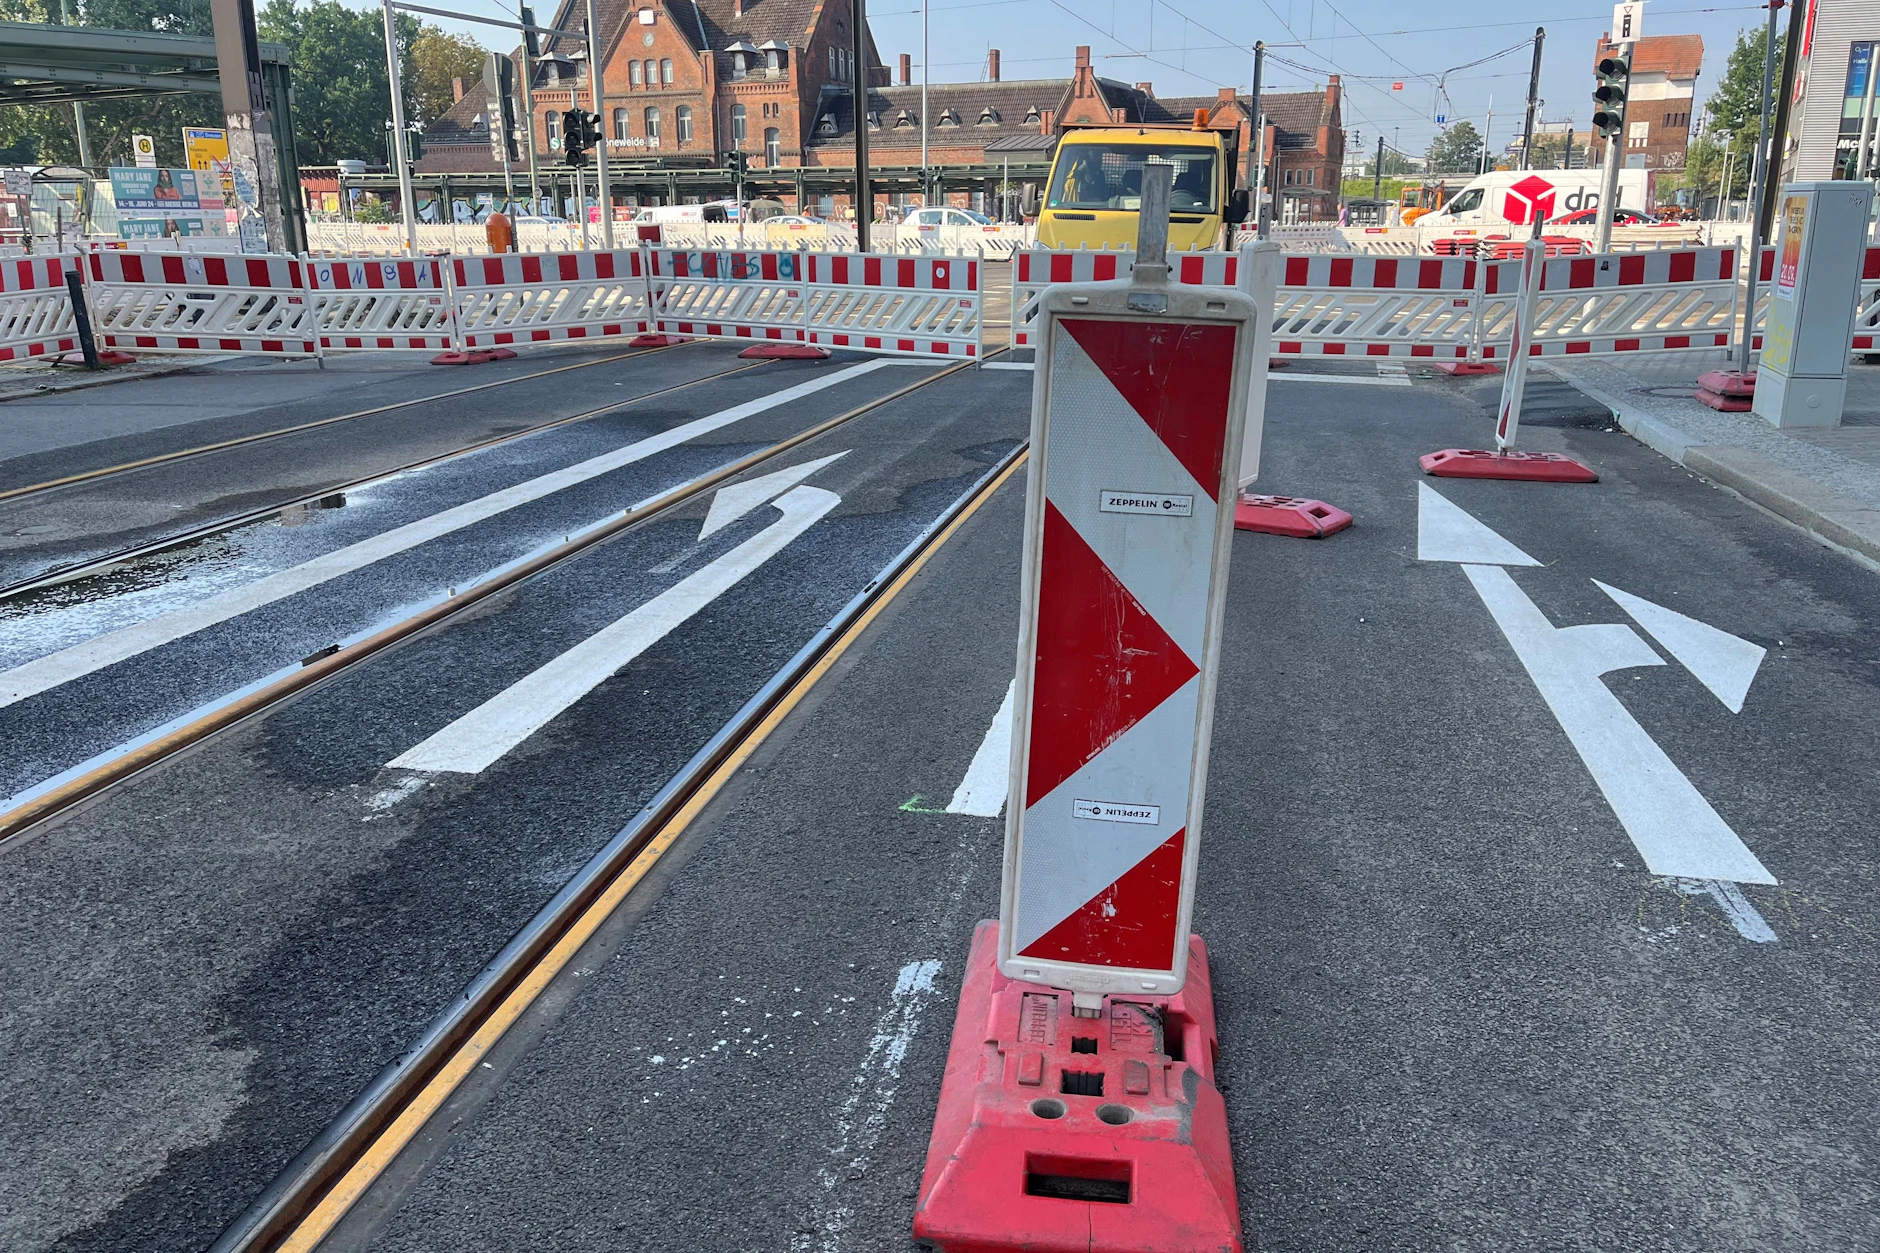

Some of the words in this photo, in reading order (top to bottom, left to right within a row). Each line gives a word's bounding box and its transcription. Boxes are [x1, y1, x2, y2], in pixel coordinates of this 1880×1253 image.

[114, 172, 135, 181] MARY
[135, 172, 152, 182] JANE
[1109, 498, 1158, 508] ZEPPELIN
[1105, 808, 1151, 818] ZEPPELIN
